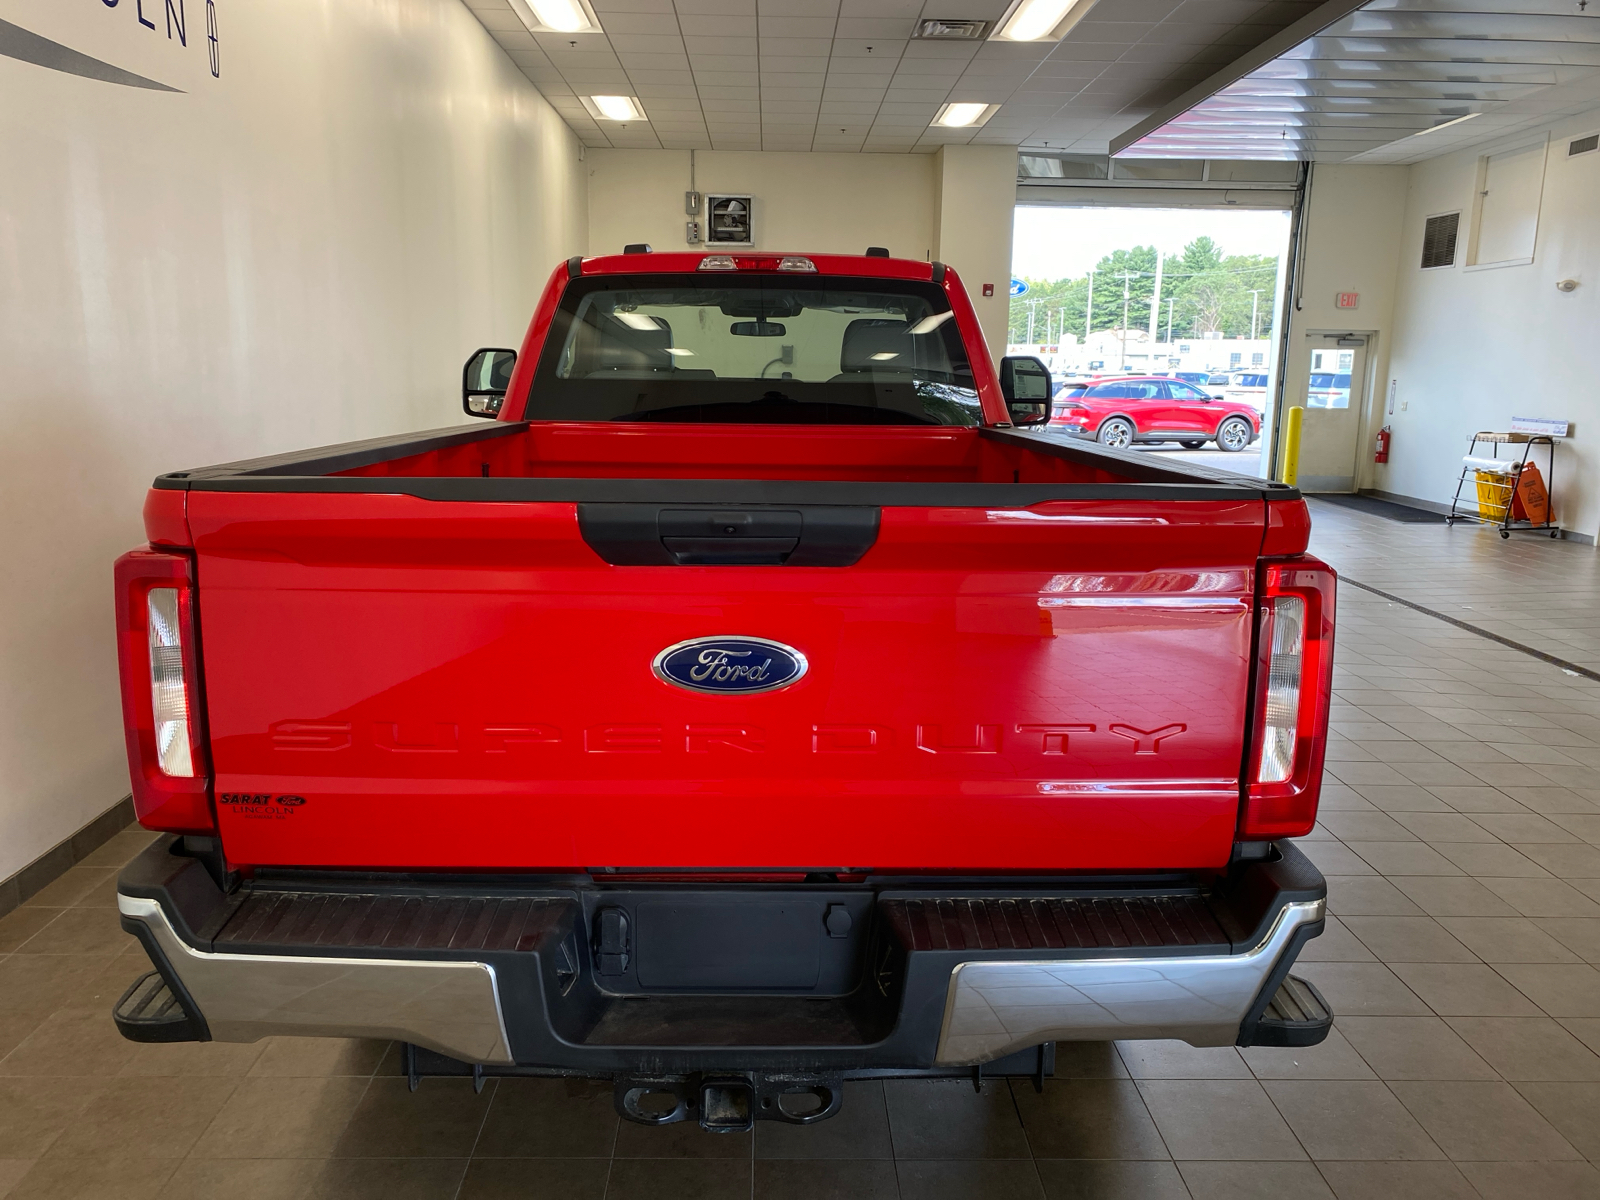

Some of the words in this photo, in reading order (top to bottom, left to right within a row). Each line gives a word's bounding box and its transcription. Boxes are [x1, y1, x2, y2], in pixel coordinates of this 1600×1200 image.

[1340, 292, 1359, 307] EXIT
[690, 648, 772, 682] Ford
[268, 718, 767, 754] SUPER
[812, 722, 1188, 755] DUTY
[221, 793, 270, 805] SARAT
[232, 805, 294, 815] LINCOLN
